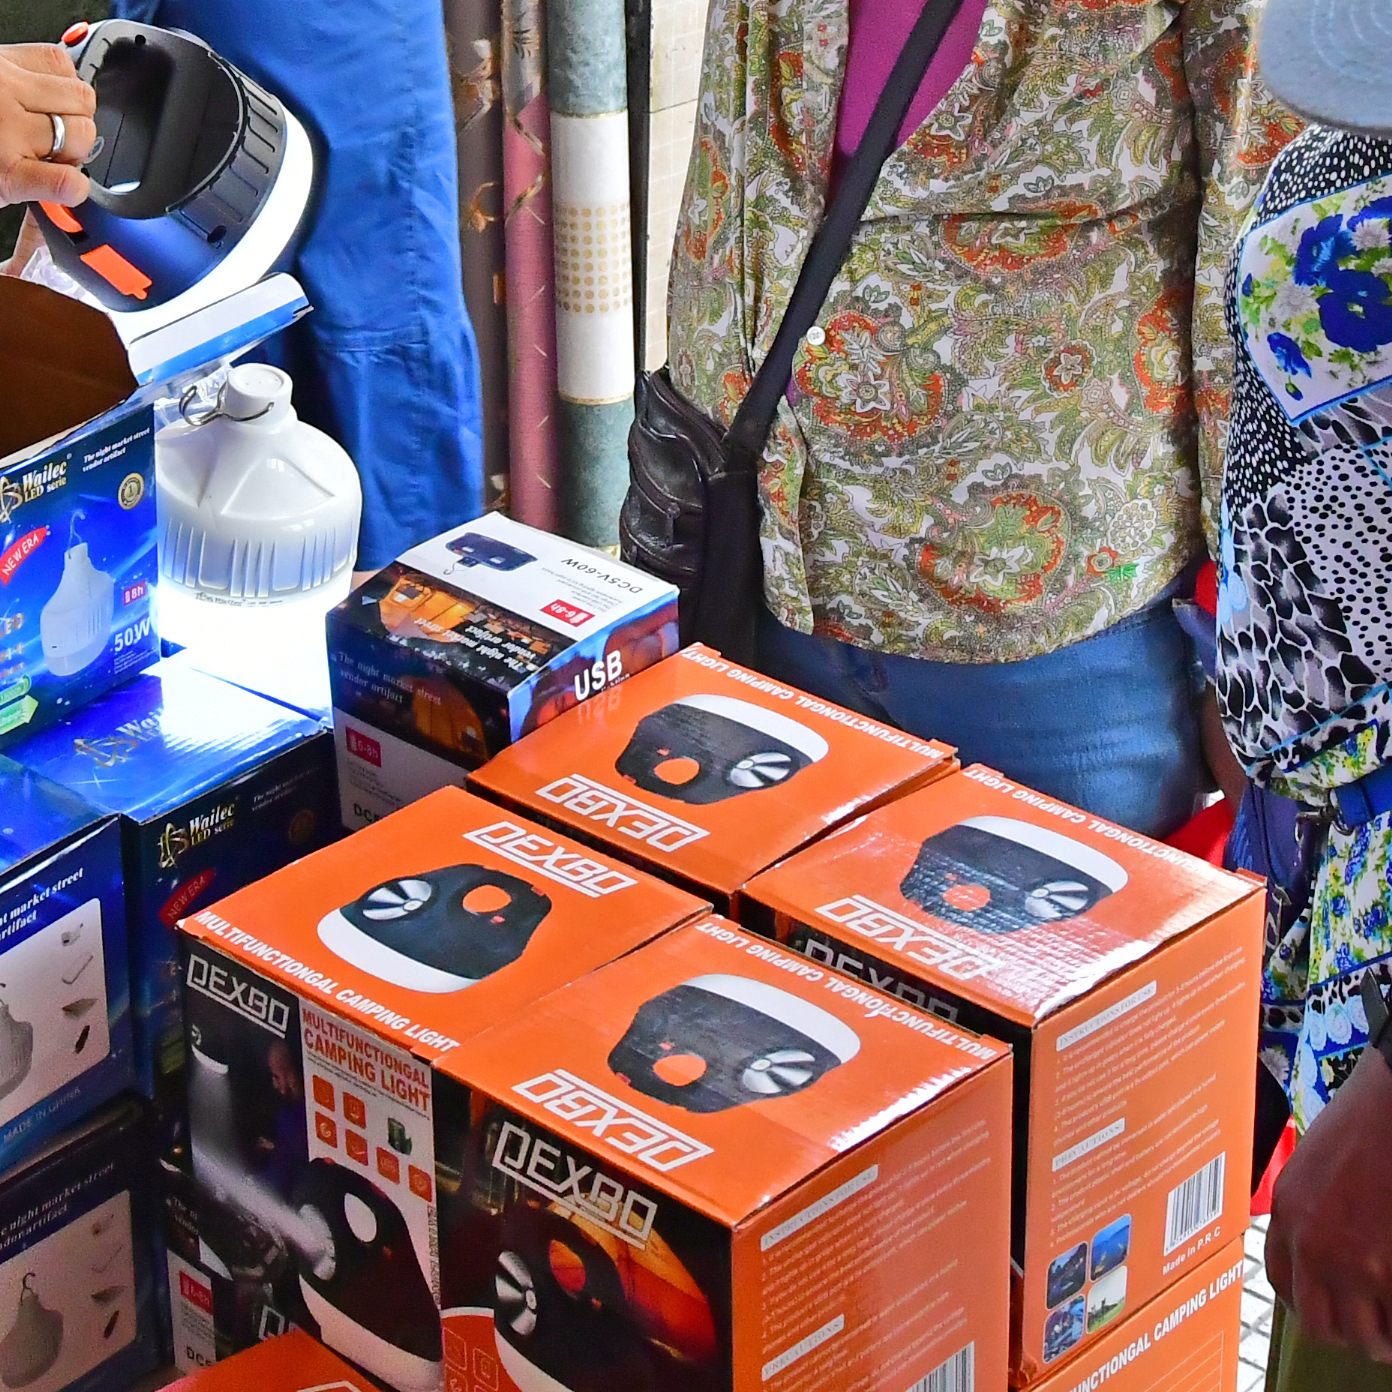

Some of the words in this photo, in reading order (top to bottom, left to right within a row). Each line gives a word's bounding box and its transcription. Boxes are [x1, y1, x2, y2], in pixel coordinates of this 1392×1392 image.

[22, 460, 69, 492] Wailec
[24, 486, 45, 503] LED
[46, 476, 68, 494] serie
[1, 547, 22, 576] NEW
[21, 532, 40, 557] ERA
[561, 557, 644, 595] DC5V-60W
[130, 584, 145, 600] 8h
[114, 616, 152, 652] 50W
[338, 651, 354, 668] The
[357, 661, 380, 682] night
[382, 671, 414, 693] market
[416, 686, 442, 706] street
[574, 649, 623, 702] USB
[681, 646, 730, 674] LIGHT
[726, 668, 796, 701] CAMPING
[340, 668, 368, 688] vendor
[371, 681, 404, 705] artifact
[795, 696, 945, 760] MULTIFUNCTIONGAL
[962, 769, 1015, 794] LIGHT
[188, 803, 236, 835] Wailec
[534, 773, 712, 853] DEXBO
[1011, 789, 1088, 825] CAMPING
[462, 820, 640, 899] DEXBO
[10, 887, 51, 920] market
[51, 867, 84, 894] street
[167, 892, 188, 920] NEW
[187, 875, 206, 897] ERA
[695, 921, 750, 951] LIGHT
[813, 894, 1007, 982] DEXBO
[194, 910, 340, 996] MULTIFUNCTIONGAL
[335, 989, 411, 1031] CAMPING
[404, 1023, 461, 1053] LIGHT
[746, 943, 825, 983] CAMPING
[186, 953, 290, 1040] DEXBO
[824, 977, 998, 1061] MULTIFUNCTIONGAL
[302, 1008, 430, 1091] MULTIFUNCTIONGAL
[304, 1026, 377, 1085] CAMPING
[380, 1069, 431, 1113] LIGHT
[511, 1068, 715, 1172] DEXBO
[10, 1207, 39, 1235] night
[42, 1179, 81, 1213] market
[491, 1120, 659, 1251] DEXBO
[1162, 1253, 1187, 1276] Made
[1187, 1245, 1197, 1257] in
[1153, 1288, 1208, 1342] CAMPING
[1209, 1260, 1245, 1301] LIGHT
